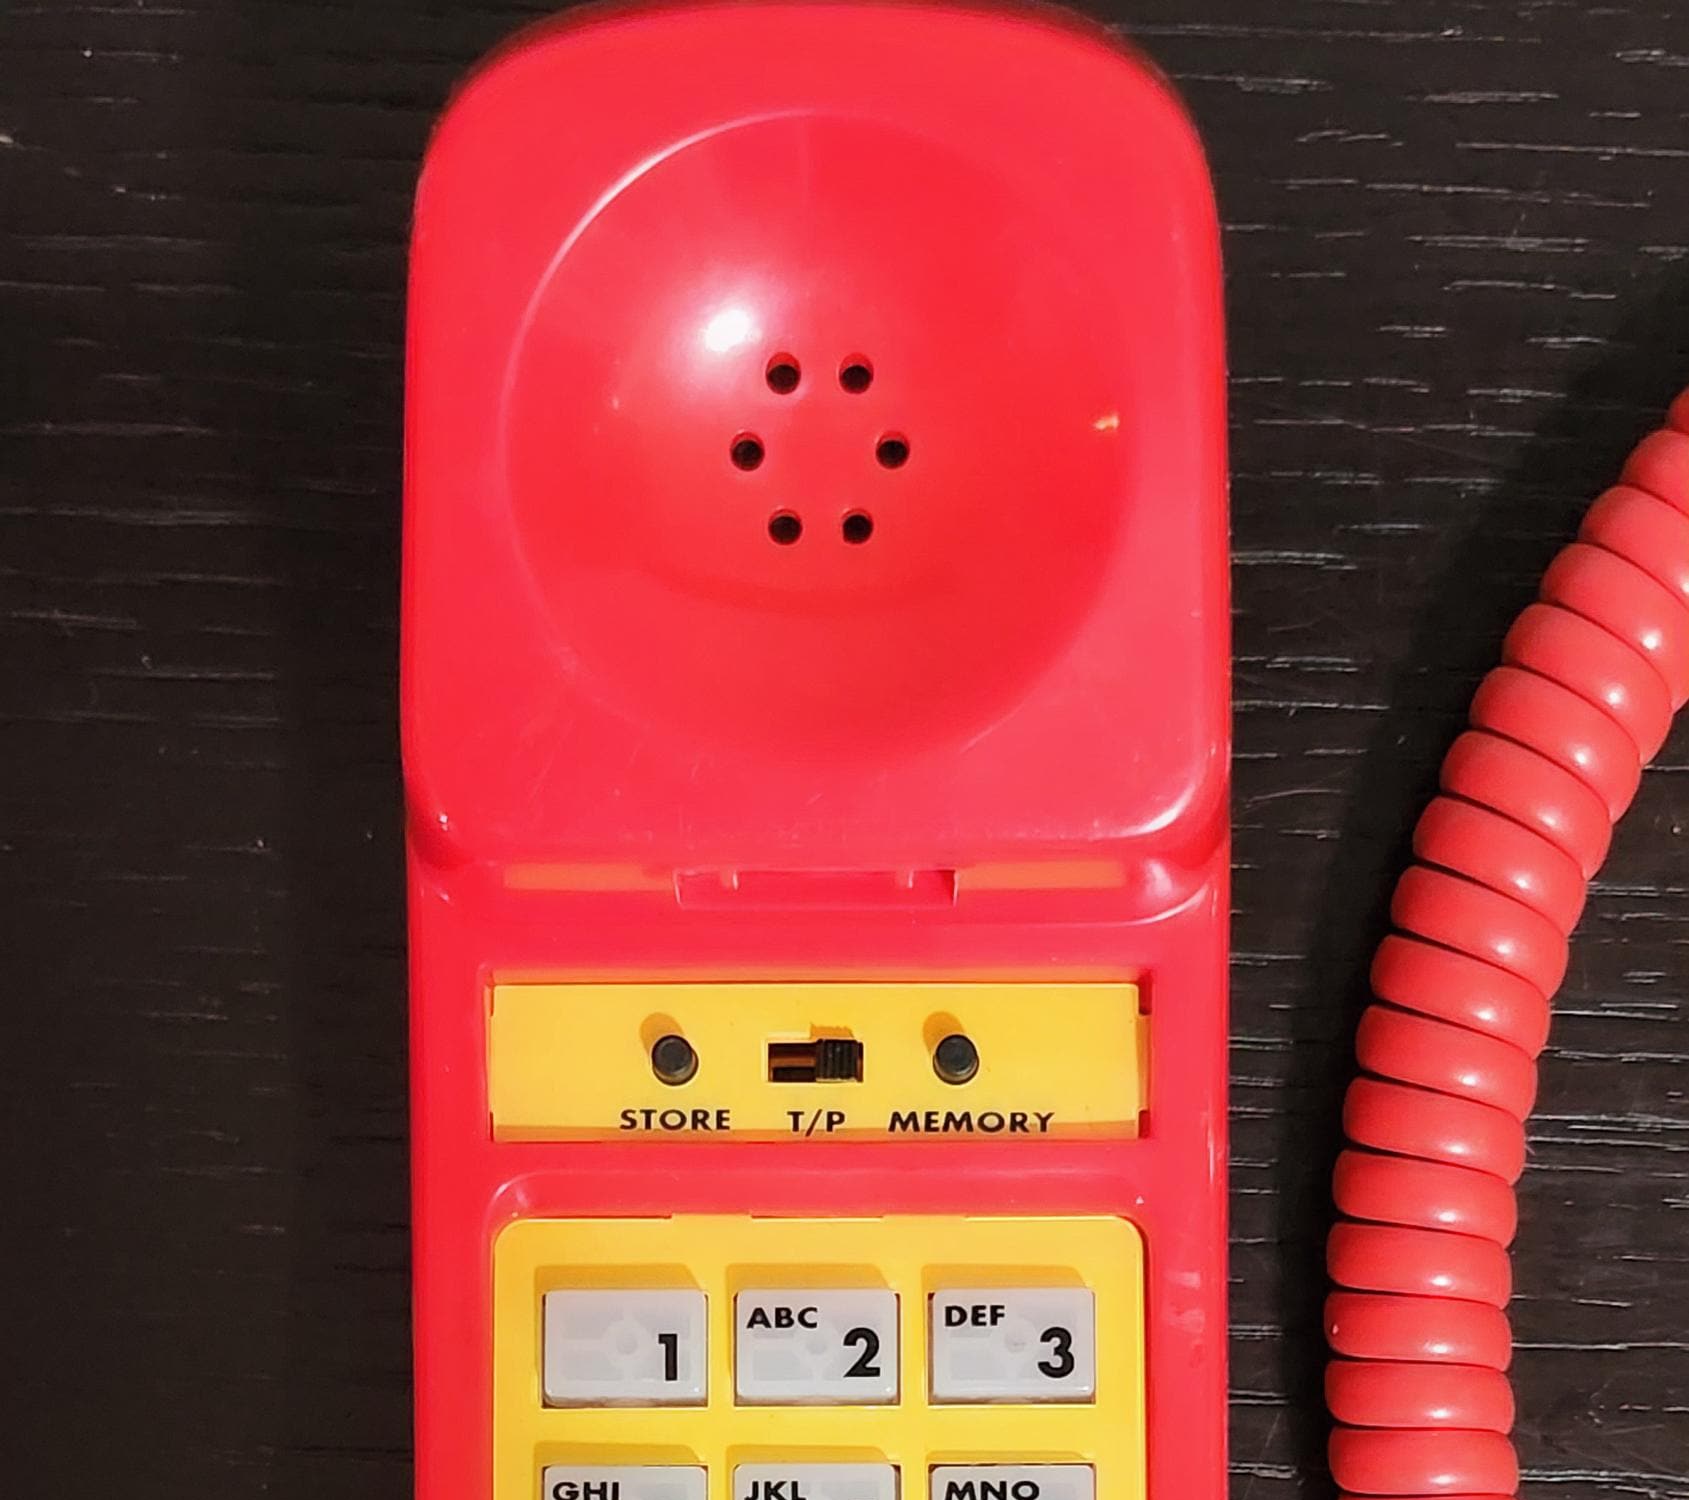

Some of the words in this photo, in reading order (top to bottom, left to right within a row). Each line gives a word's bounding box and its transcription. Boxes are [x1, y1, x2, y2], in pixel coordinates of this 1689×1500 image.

[620, 1109, 730, 1130] STORE
[787, 1109, 845, 1136] T/P
[888, 1111, 1053, 1133] MEMORY
[746, 1306, 818, 1329] ABC
[944, 1304, 1005, 1327] DEF
[658, 1333, 678, 1382] 1
[843, 1327, 881, 1378] 2
[1037, 1326, 1075, 1379] 3
